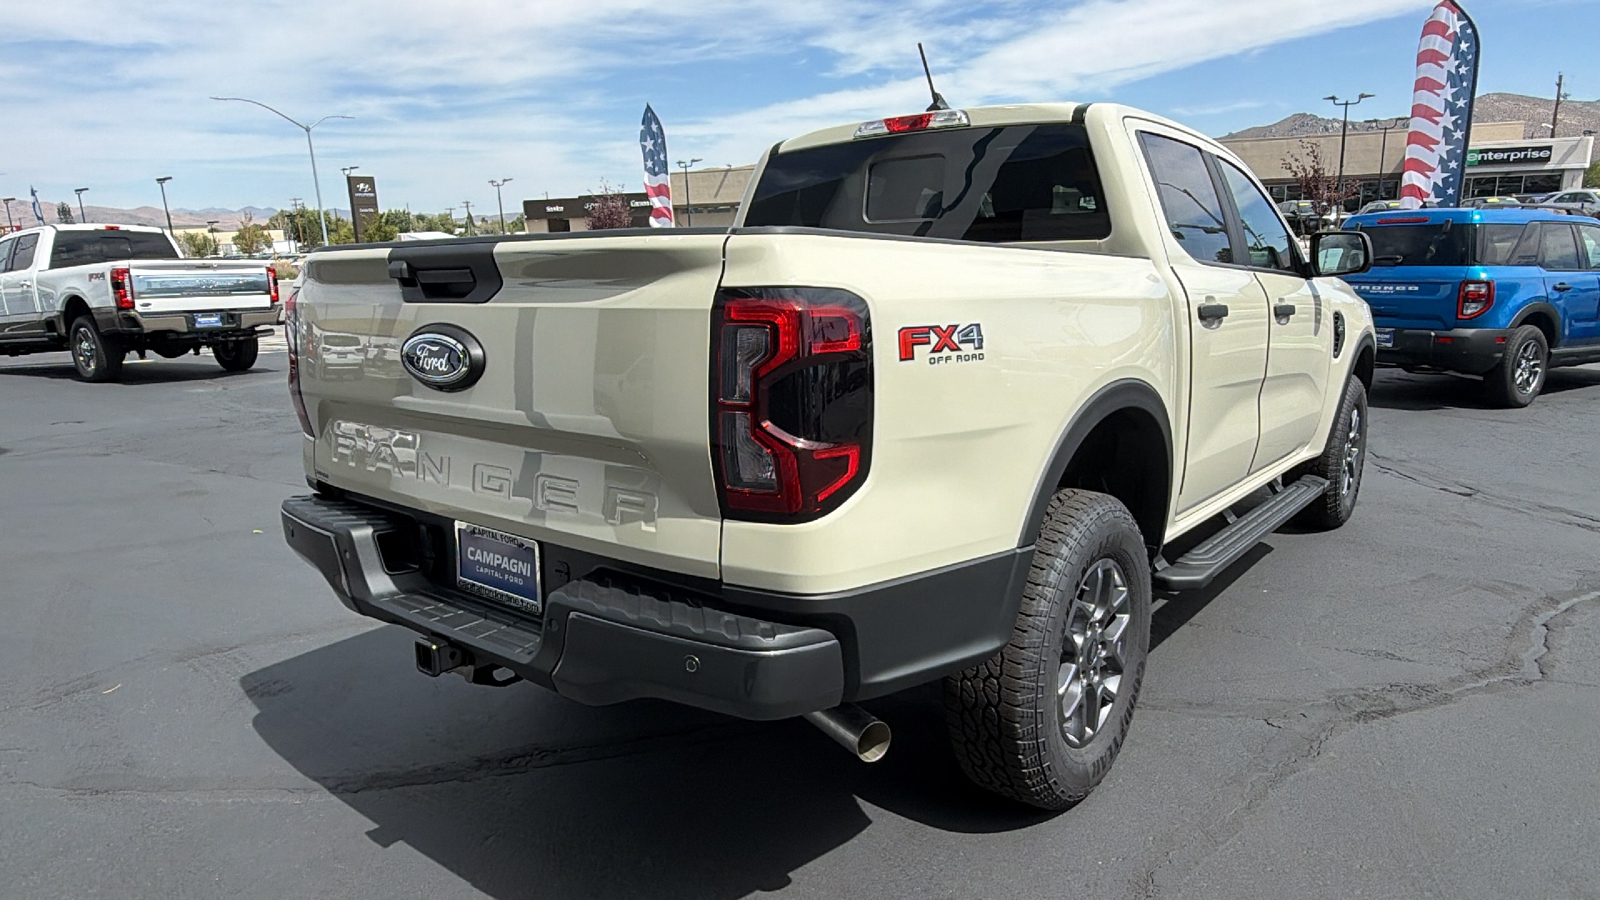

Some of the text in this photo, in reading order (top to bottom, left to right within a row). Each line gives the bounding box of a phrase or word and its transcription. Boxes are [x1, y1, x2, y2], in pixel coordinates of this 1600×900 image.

[1467, 148, 1551, 162] enterprise
[898, 323, 984, 362] FX4
[414, 343, 450, 372] Ford
[929, 353, 985, 365] OFF ROAD
[331, 431, 659, 533] RANGER
[473, 526, 520, 546] CAPITAL FORD
[467, 546, 531, 577] CAMPAGNI
[476, 565, 524, 586] CAPITAL FORD
